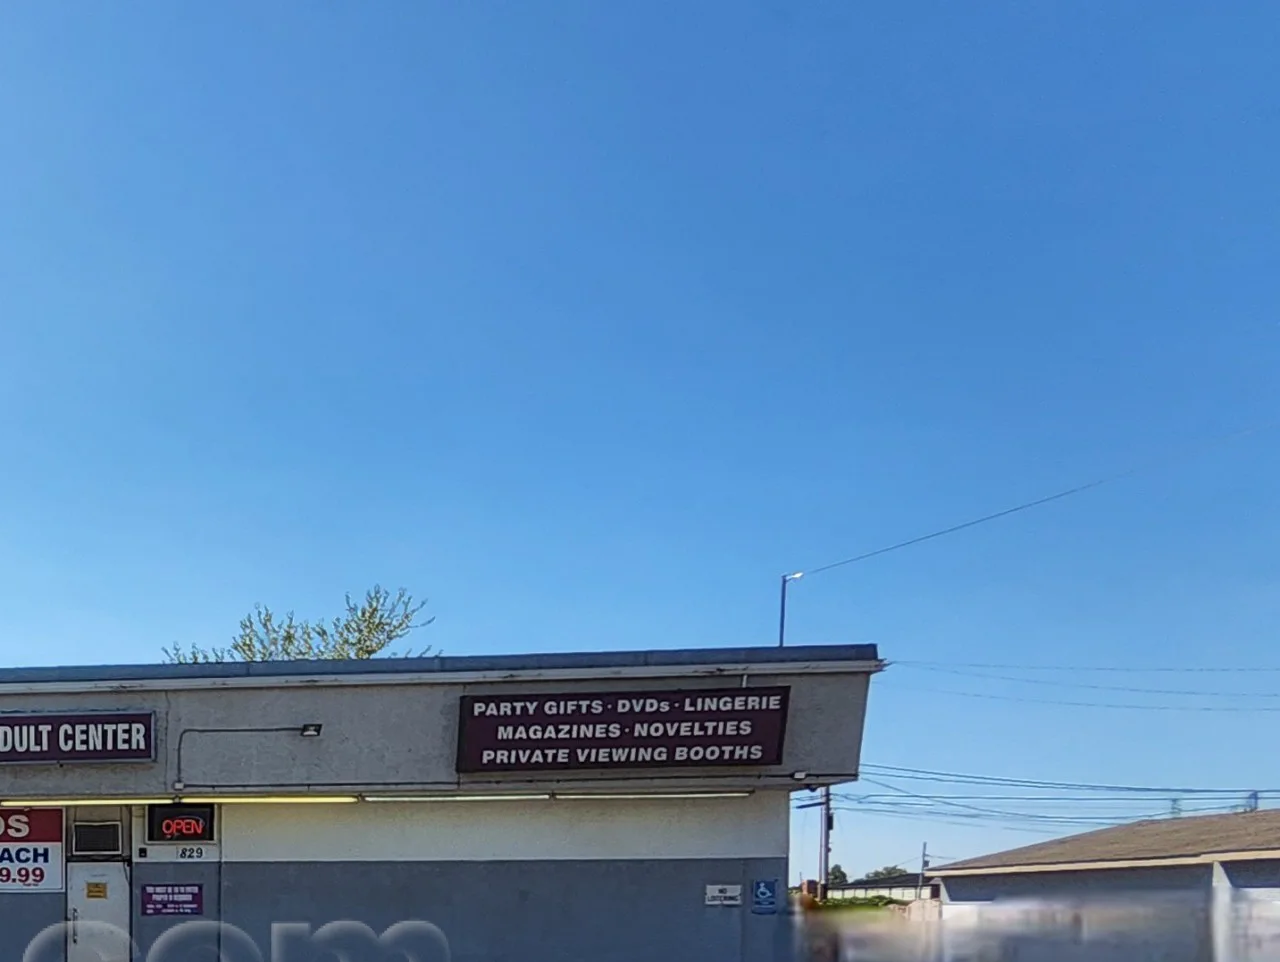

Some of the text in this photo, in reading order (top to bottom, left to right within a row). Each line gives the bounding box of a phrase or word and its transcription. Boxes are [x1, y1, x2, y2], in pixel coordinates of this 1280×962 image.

[473, 696, 781, 716] PARTY GIFTS DVDs LINGERIE
[59, 723, 146, 751] CENTER
[497, 721, 752, 740] MAGAZINES NOVELTIES
[482, 745, 763, 764] PRIVATE VIEWING BOOTHS
[162, 819, 203, 834] OPEN
[180, 847, 203, 858] 829
